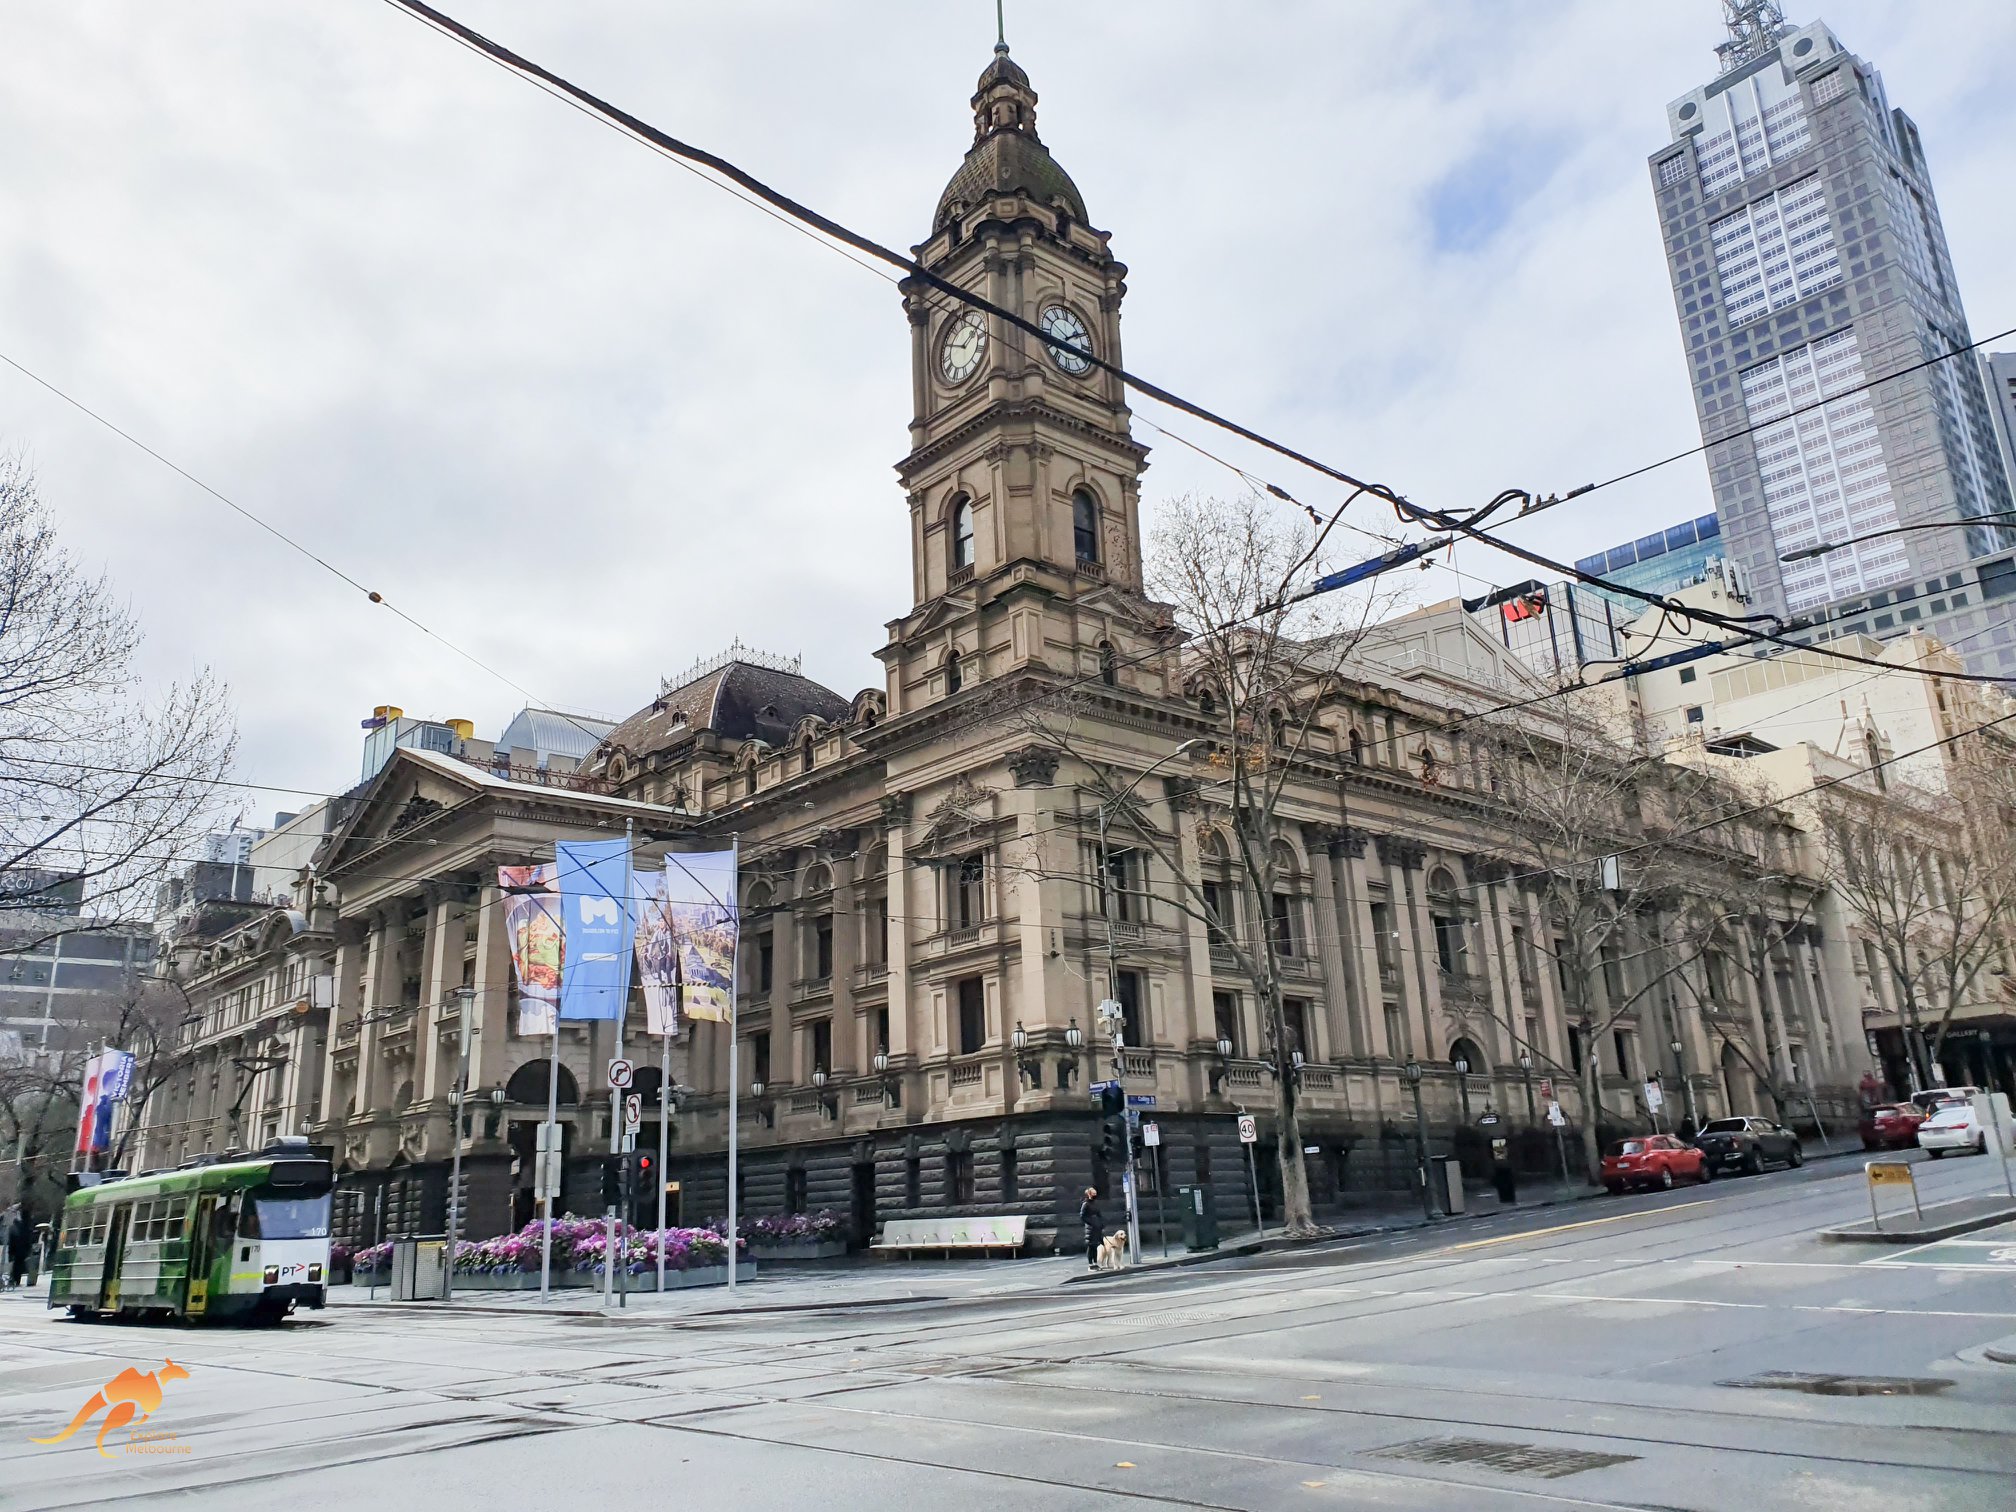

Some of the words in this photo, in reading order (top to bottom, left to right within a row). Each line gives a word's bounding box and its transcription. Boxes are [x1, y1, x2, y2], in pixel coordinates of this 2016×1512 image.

[112, 1056, 127, 1097] VICTORIA
[1241, 1124, 1253, 1134] 40
[311, 1227, 327, 1236] 170
